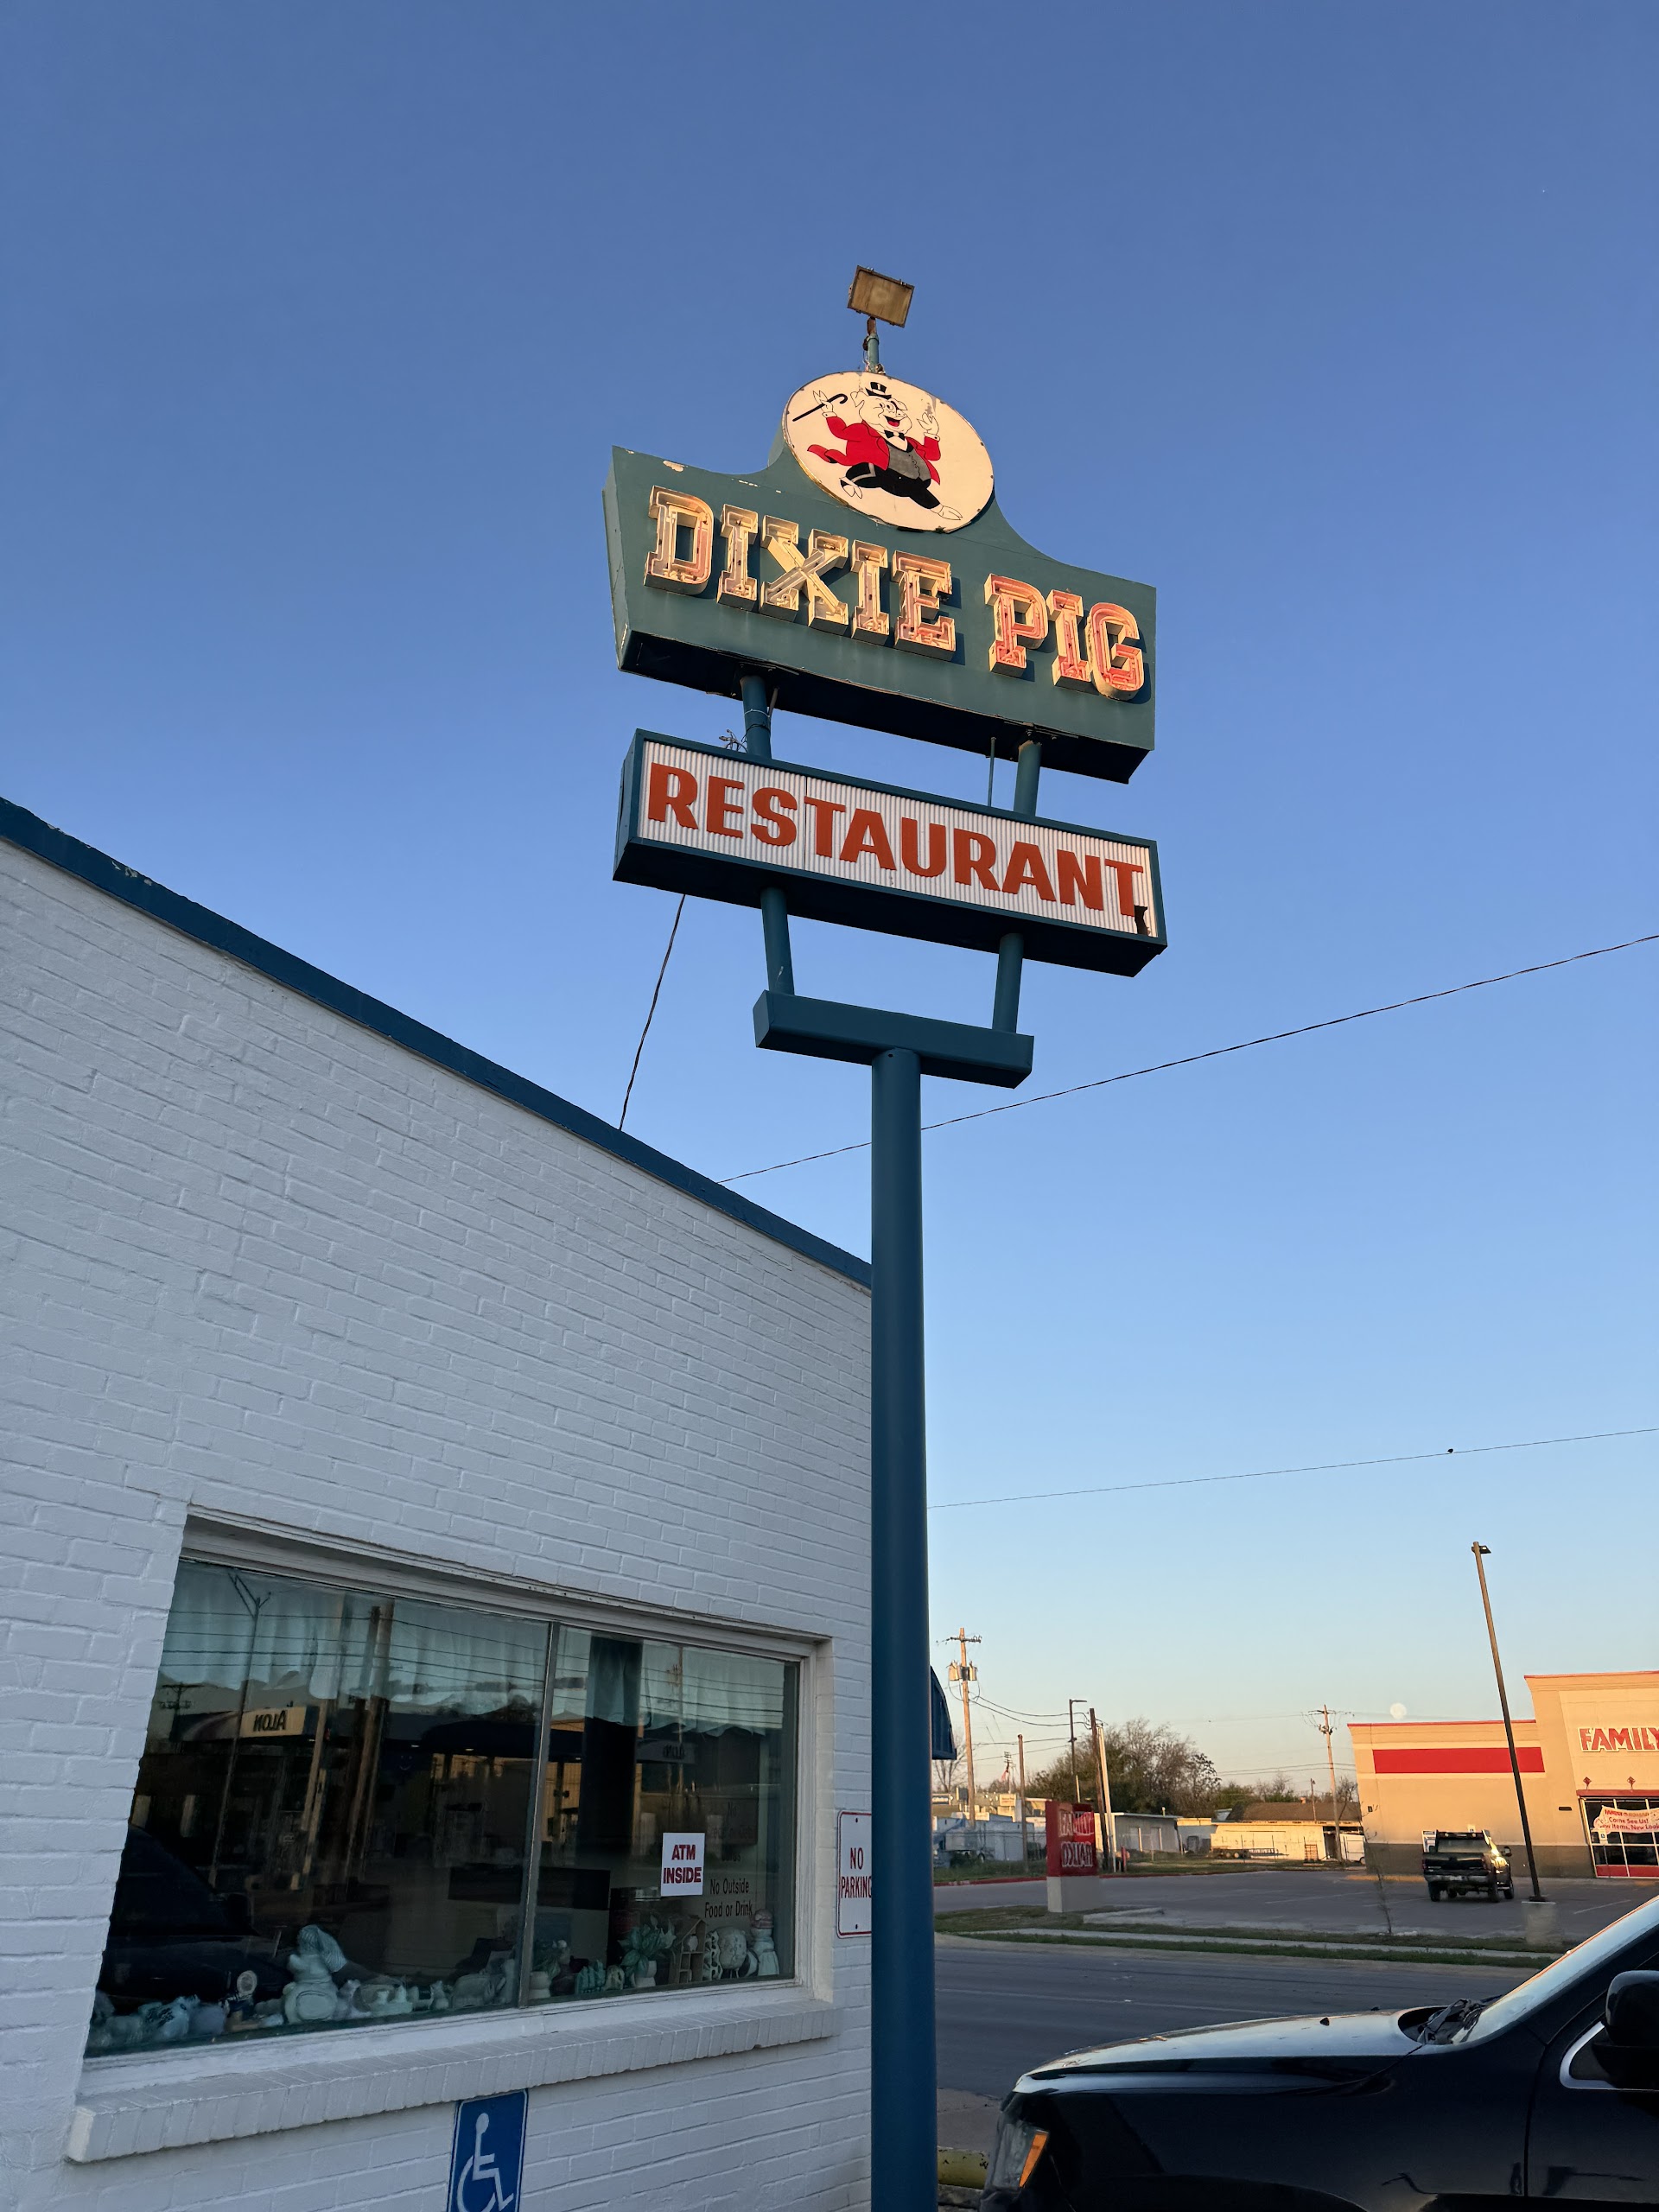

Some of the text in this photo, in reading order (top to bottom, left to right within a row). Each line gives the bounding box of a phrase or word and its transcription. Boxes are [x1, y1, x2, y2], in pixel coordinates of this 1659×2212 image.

[643, 485, 1144, 701] DIXIE PIG
[647, 762, 1144, 917] RESTAURANT
[1578, 1727, 1659, 1752] FAMILY
[671, 1844, 696, 1860] ATM
[849, 1847, 864, 1870] NO
[663, 1866, 702, 1885] INSIDE
[709, 1878, 749, 1895] No Outside
[704, 1900, 753, 1918] Food or Drink
